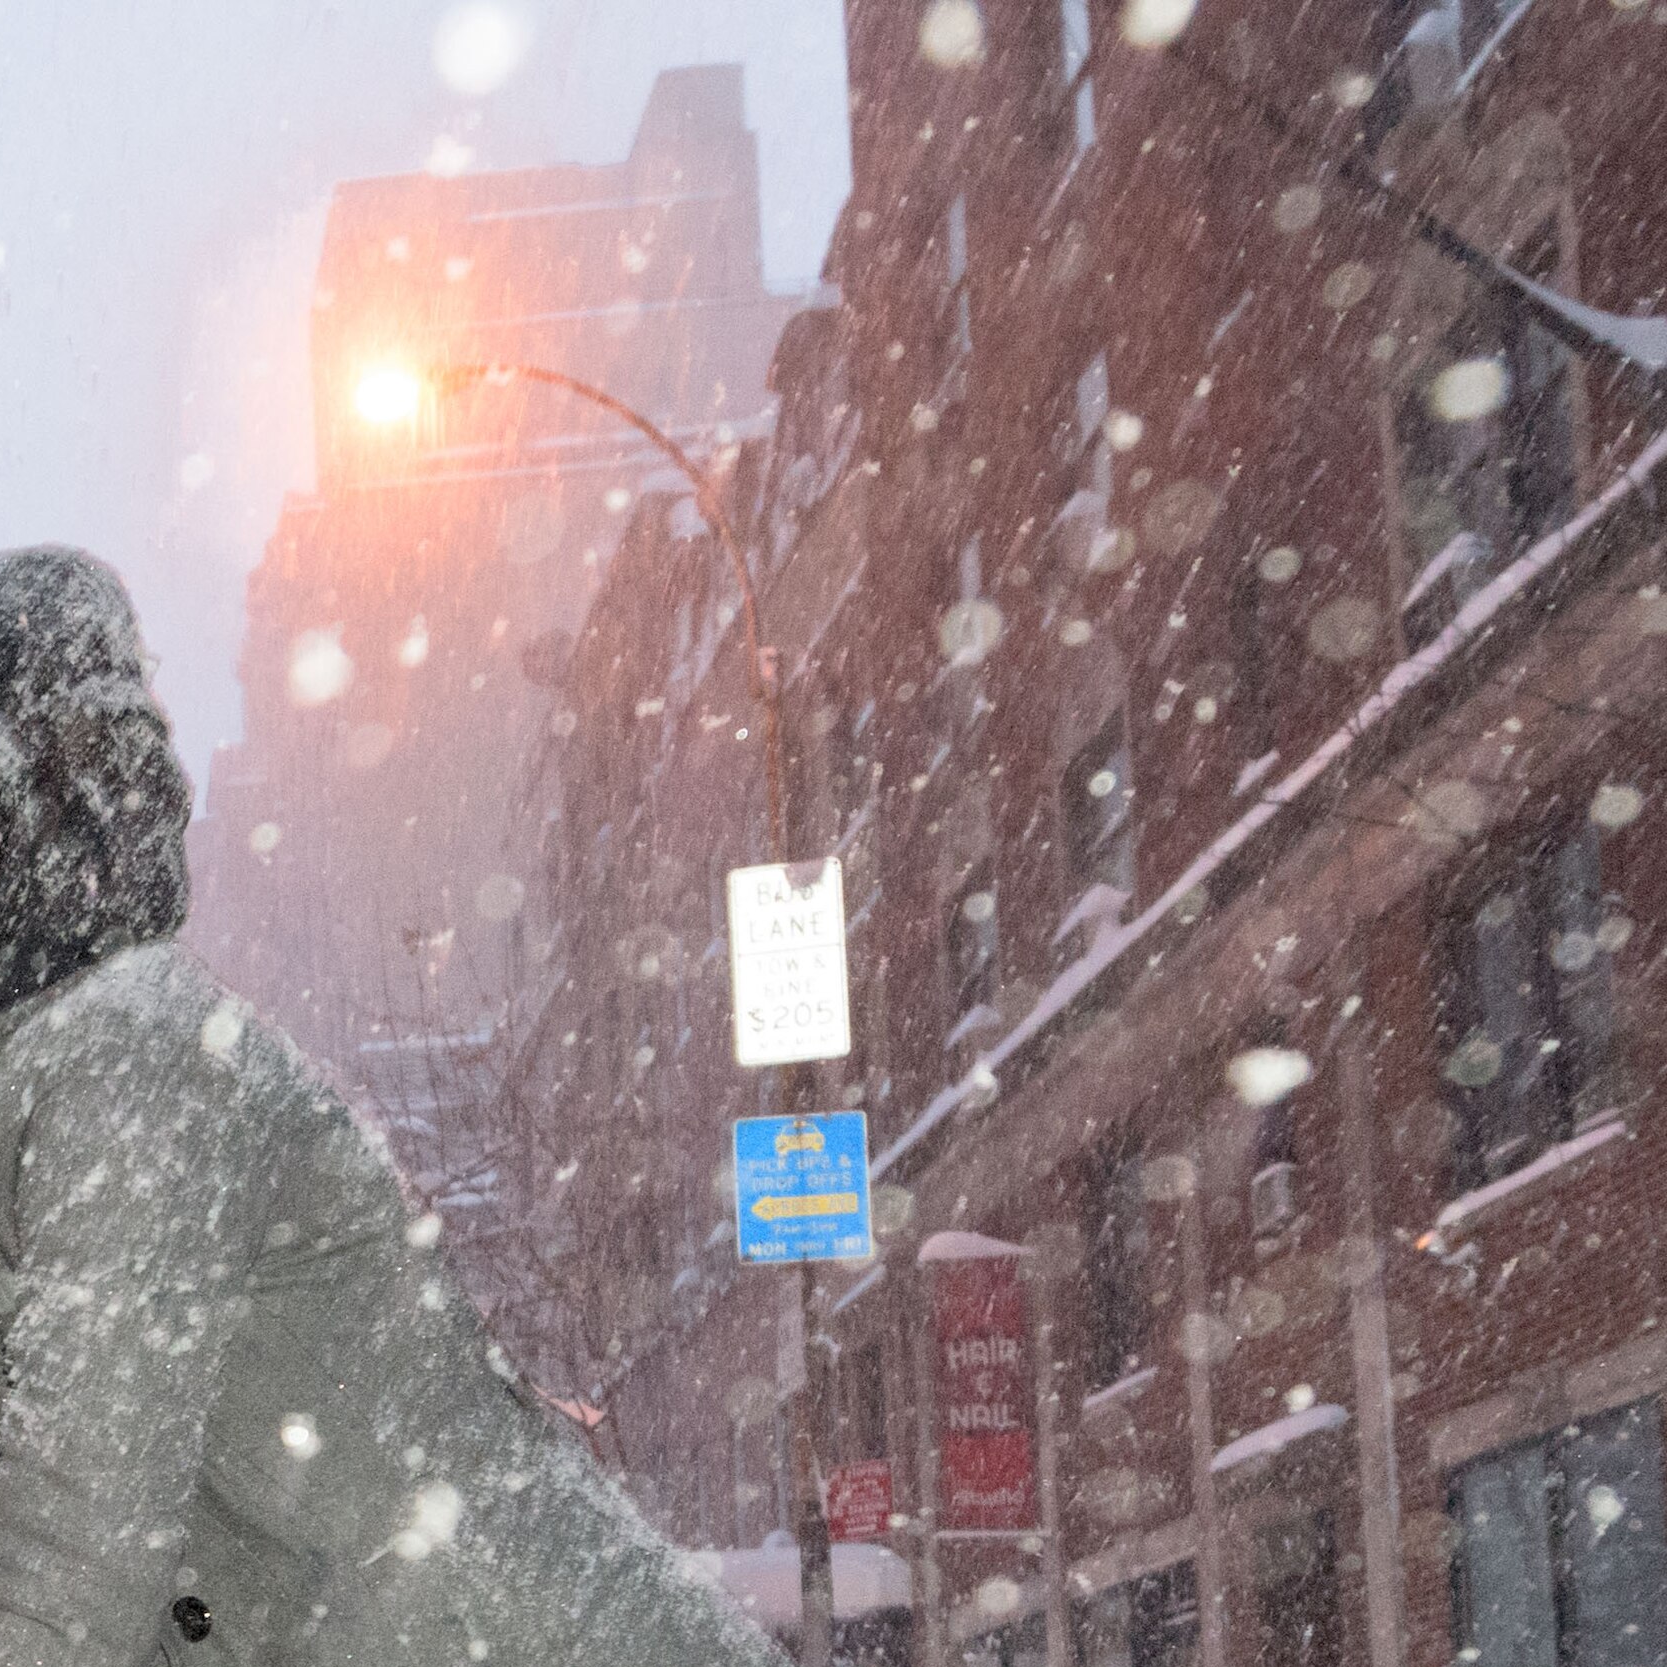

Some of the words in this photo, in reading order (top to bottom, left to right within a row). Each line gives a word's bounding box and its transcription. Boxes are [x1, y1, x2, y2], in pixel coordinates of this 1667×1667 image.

[749, 912, 826, 943] LANE
[747, 1000, 835, 1033] $205
[751, 1175, 799, 1191] DROP
[806, 1170, 852, 1189] OFFS
[748, 1242, 787, 1257] MON
[948, 1338, 1018, 1370] HAIR
[949, 1403, 1019, 1429] NAIL
